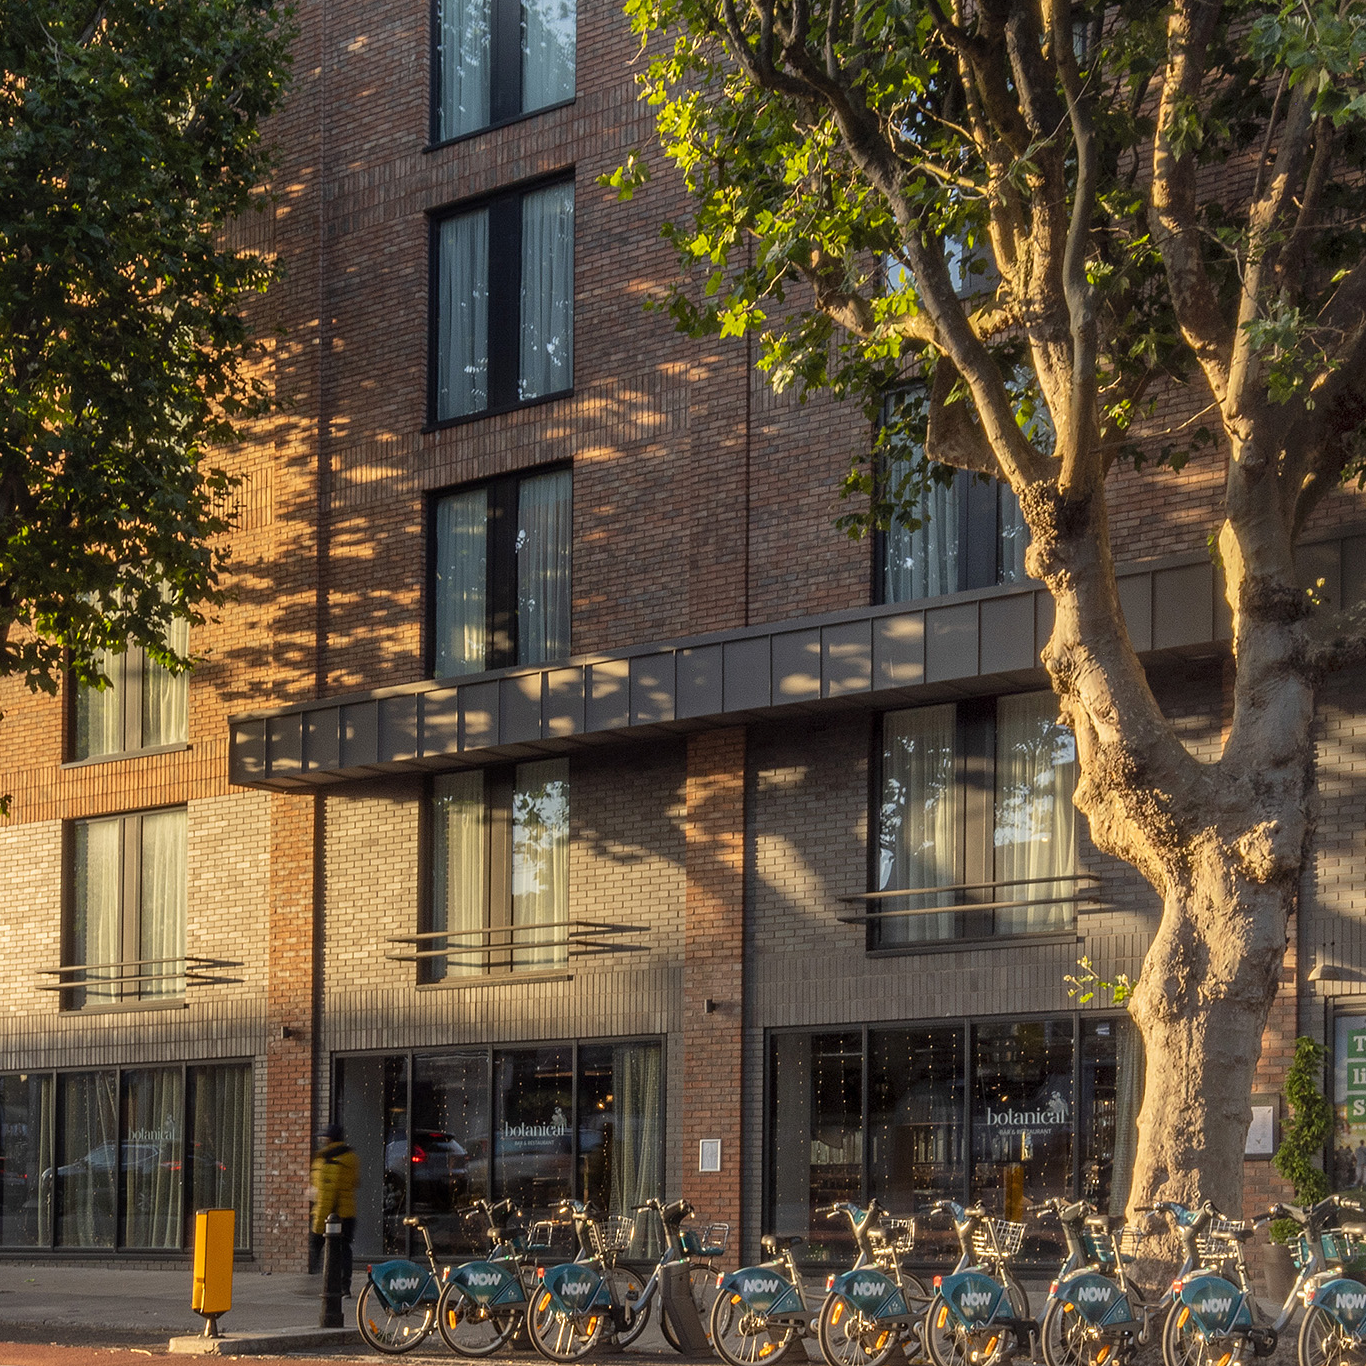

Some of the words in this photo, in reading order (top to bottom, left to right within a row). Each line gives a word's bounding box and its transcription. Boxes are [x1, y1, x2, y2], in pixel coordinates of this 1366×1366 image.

[987, 1107, 1065, 1125] botanical
[128, 1126, 175, 1140] botanical
[505, 1121, 564, 1136] botanical
[389, 1277, 420, 1292] NOW
[468, 1273, 502, 1286] NOW
[743, 1279, 779, 1293] NOW
[561, 1283, 591, 1296] NOW
[853, 1282, 886, 1296] NOW
[1078, 1287, 1111, 1302] NOW
[961, 1292, 992, 1307] NOW
[1202, 1298, 1233, 1313] NOW
[1336, 1293, 1366, 1309] NOW
